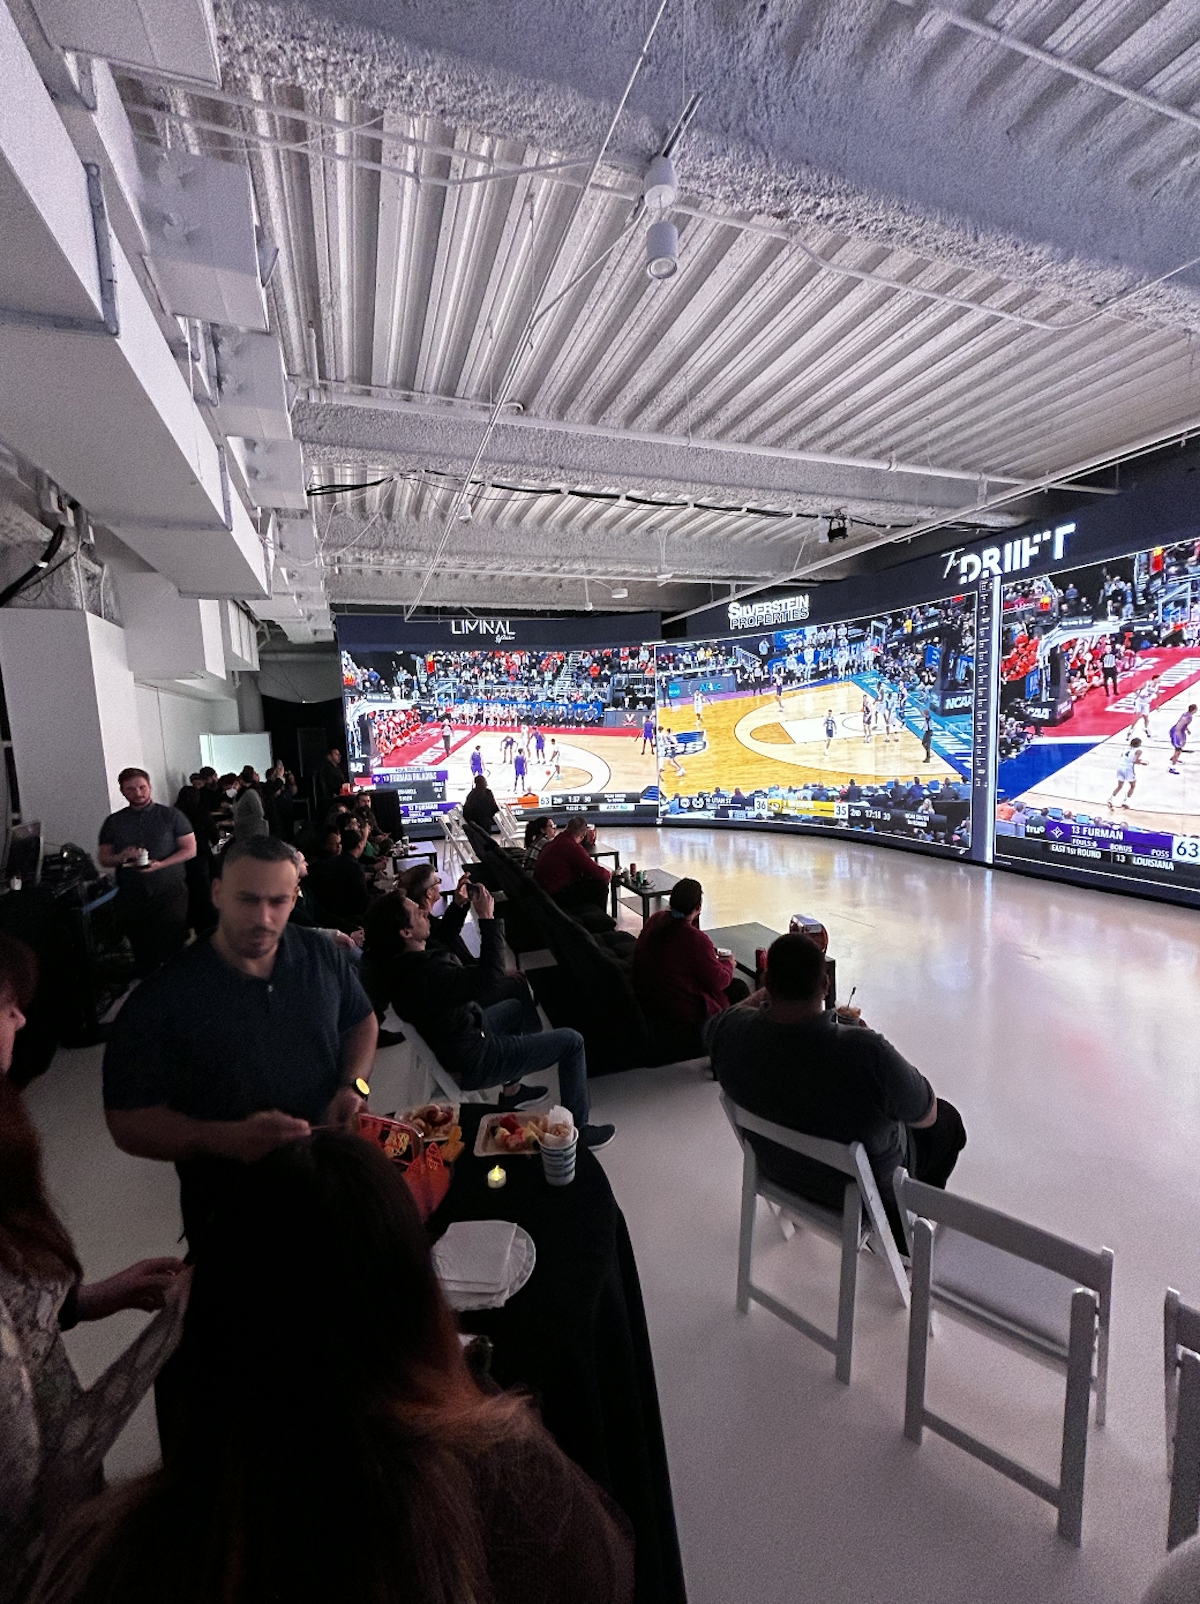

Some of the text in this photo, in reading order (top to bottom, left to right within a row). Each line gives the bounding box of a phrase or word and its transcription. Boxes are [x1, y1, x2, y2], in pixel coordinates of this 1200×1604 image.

[729, 607, 809, 630] PROPERTIES
[451, 619, 516, 635] LIMINAL
[540, 795, 550, 805] 63
[756, 800, 766, 810] 36
[835, 806, 847, 816] 35
[1071, 825, 1124, 840] 13 FURMAN
[1051, 844, 1066, 854] EAST
[1077, 847, 1101, 859] ROUND
[1110, 843, 1133, 853] BONUS
[1151, 849, 1170, 858] POSS
[1176, 840, 1199, 859] 63
[1116, 854, 1175, 871] 13 LOUISIANA
